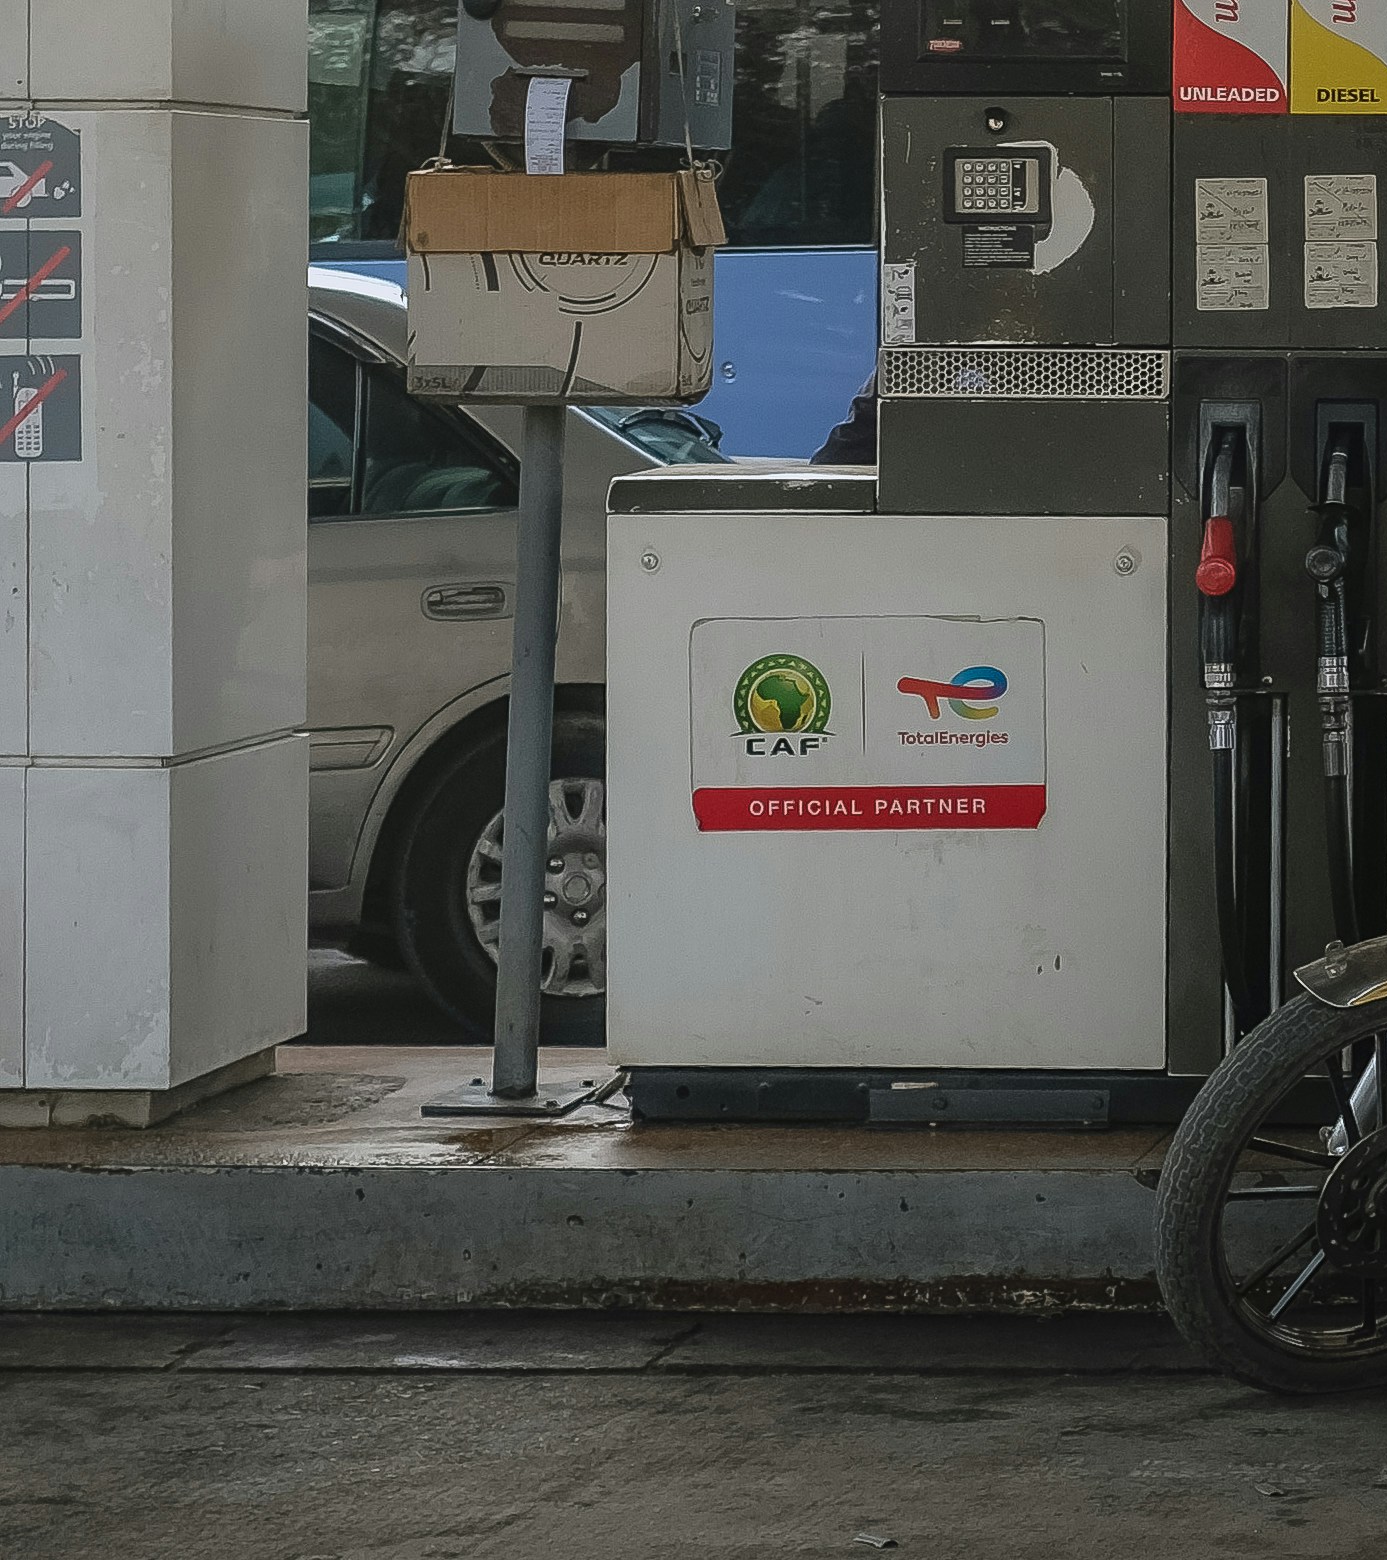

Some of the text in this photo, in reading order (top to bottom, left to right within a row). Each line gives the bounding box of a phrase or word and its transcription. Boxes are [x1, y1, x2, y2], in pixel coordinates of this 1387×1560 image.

[1180, 87, 1280, 102] UNLEADED
[1316, 88, 1380, 102] DIESEL
[9, 113, 47, 129] STOP
[538, 252, 630, 267] QUARTZ
[745, 737, 821, 757] CAF
[898, 730, 1009, 748] TotalEnergies
[749, 798, 986, 816] OFFICIAL PARTNER
